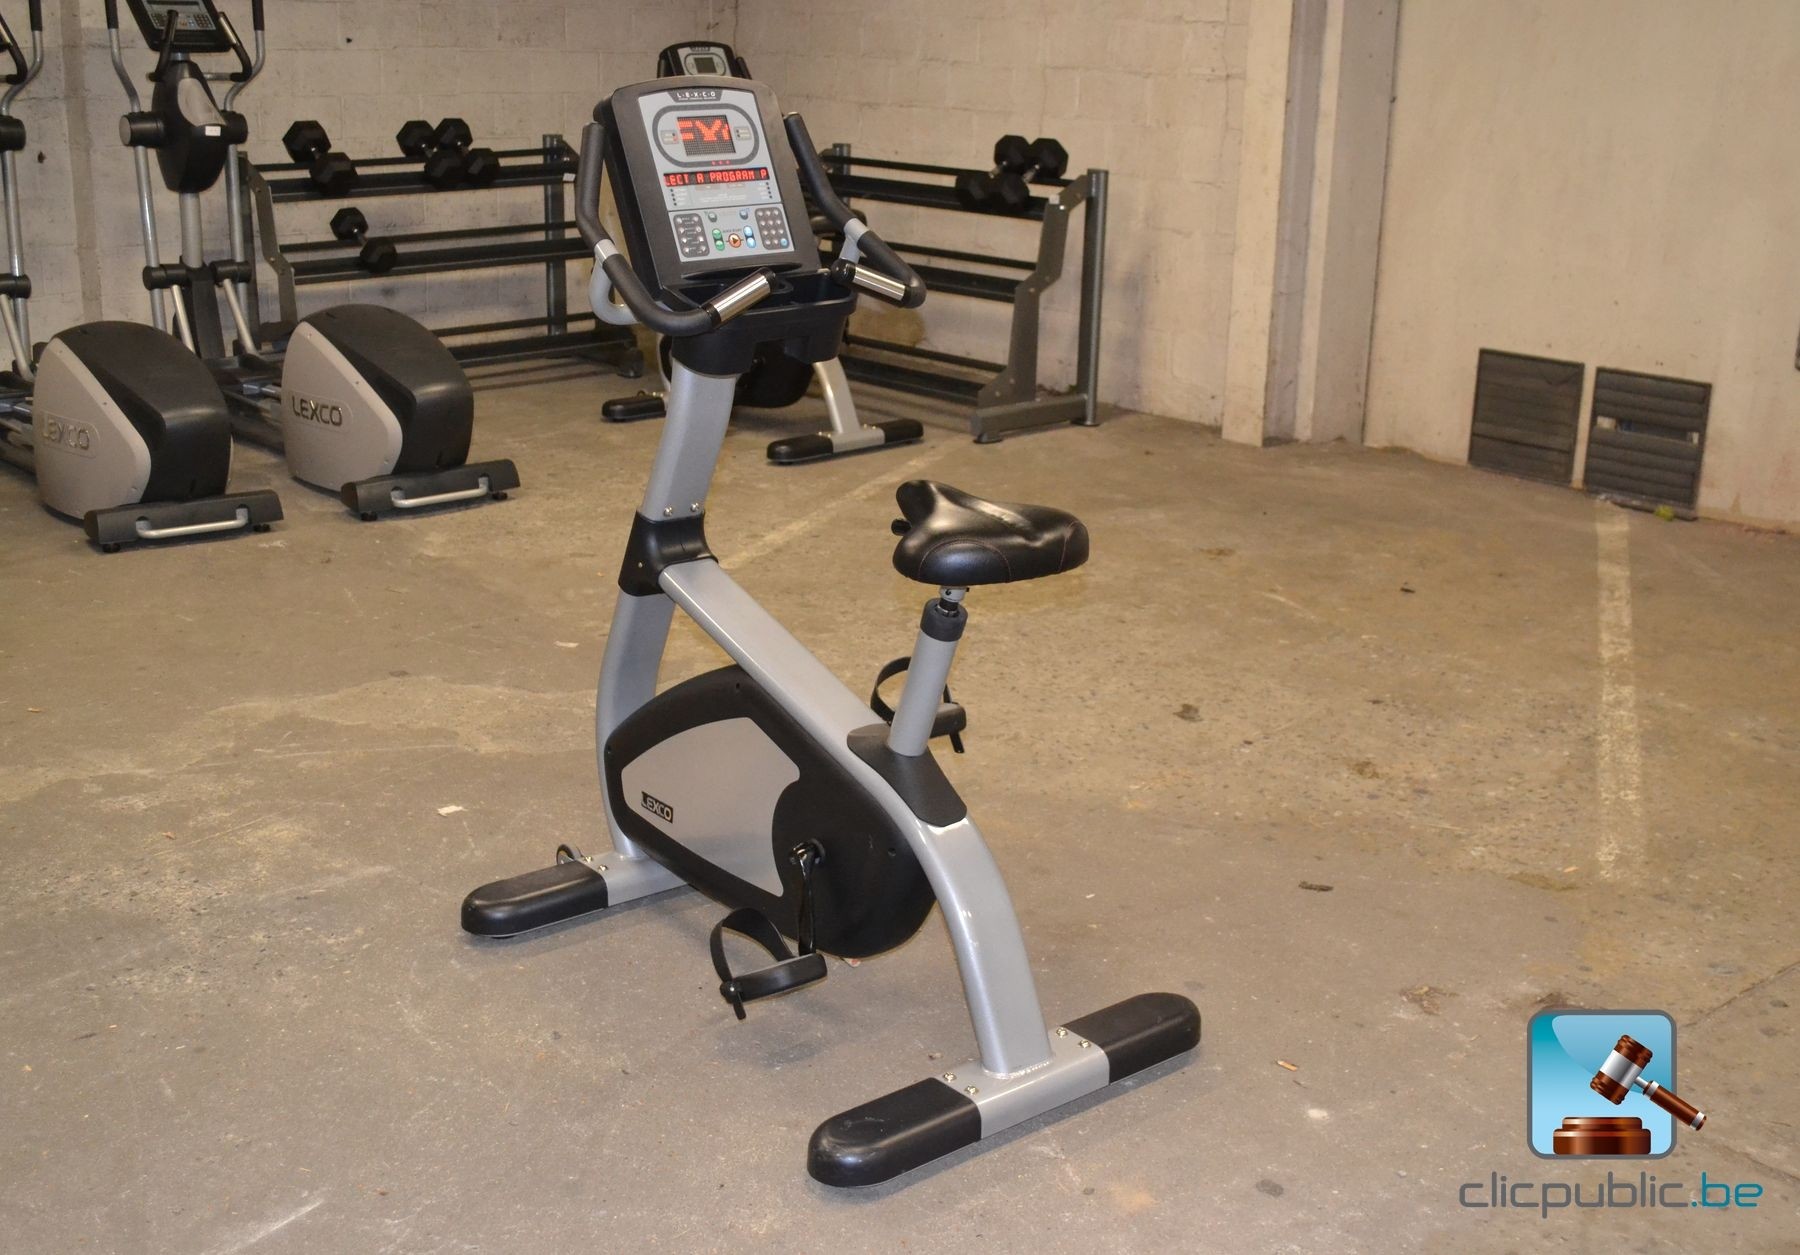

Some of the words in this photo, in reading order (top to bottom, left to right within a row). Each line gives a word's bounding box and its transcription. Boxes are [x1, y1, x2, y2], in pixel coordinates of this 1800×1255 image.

[696, 173, 705, 184] A
[709, 169, 755, 183] PROGRAM
[291, 396, 343, 427] LEXCO
[641, 793, 672, 821] LEXCO
